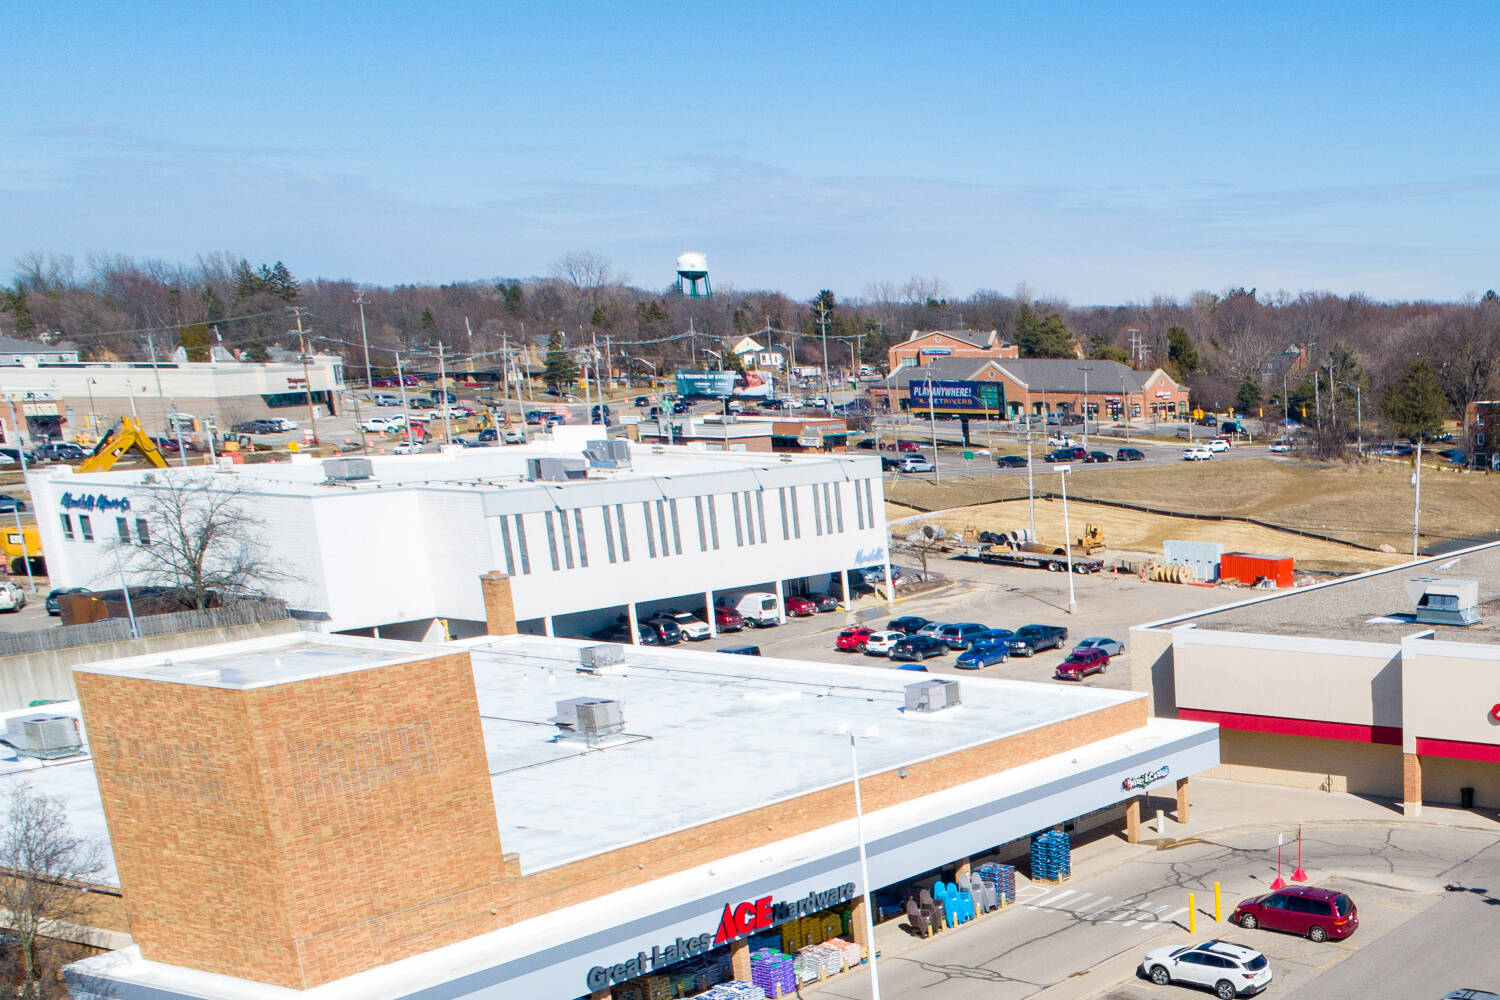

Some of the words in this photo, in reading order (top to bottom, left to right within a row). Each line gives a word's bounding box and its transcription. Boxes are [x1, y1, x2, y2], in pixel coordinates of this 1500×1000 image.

[932, 387, 972, 397] ANYWHERE!
[587, 951, 649, 990] Great
[651, 932, 712, 966] Lakes
[714, 895, 774, 944] ACE
[772, 882, 857, 922] Hardware
